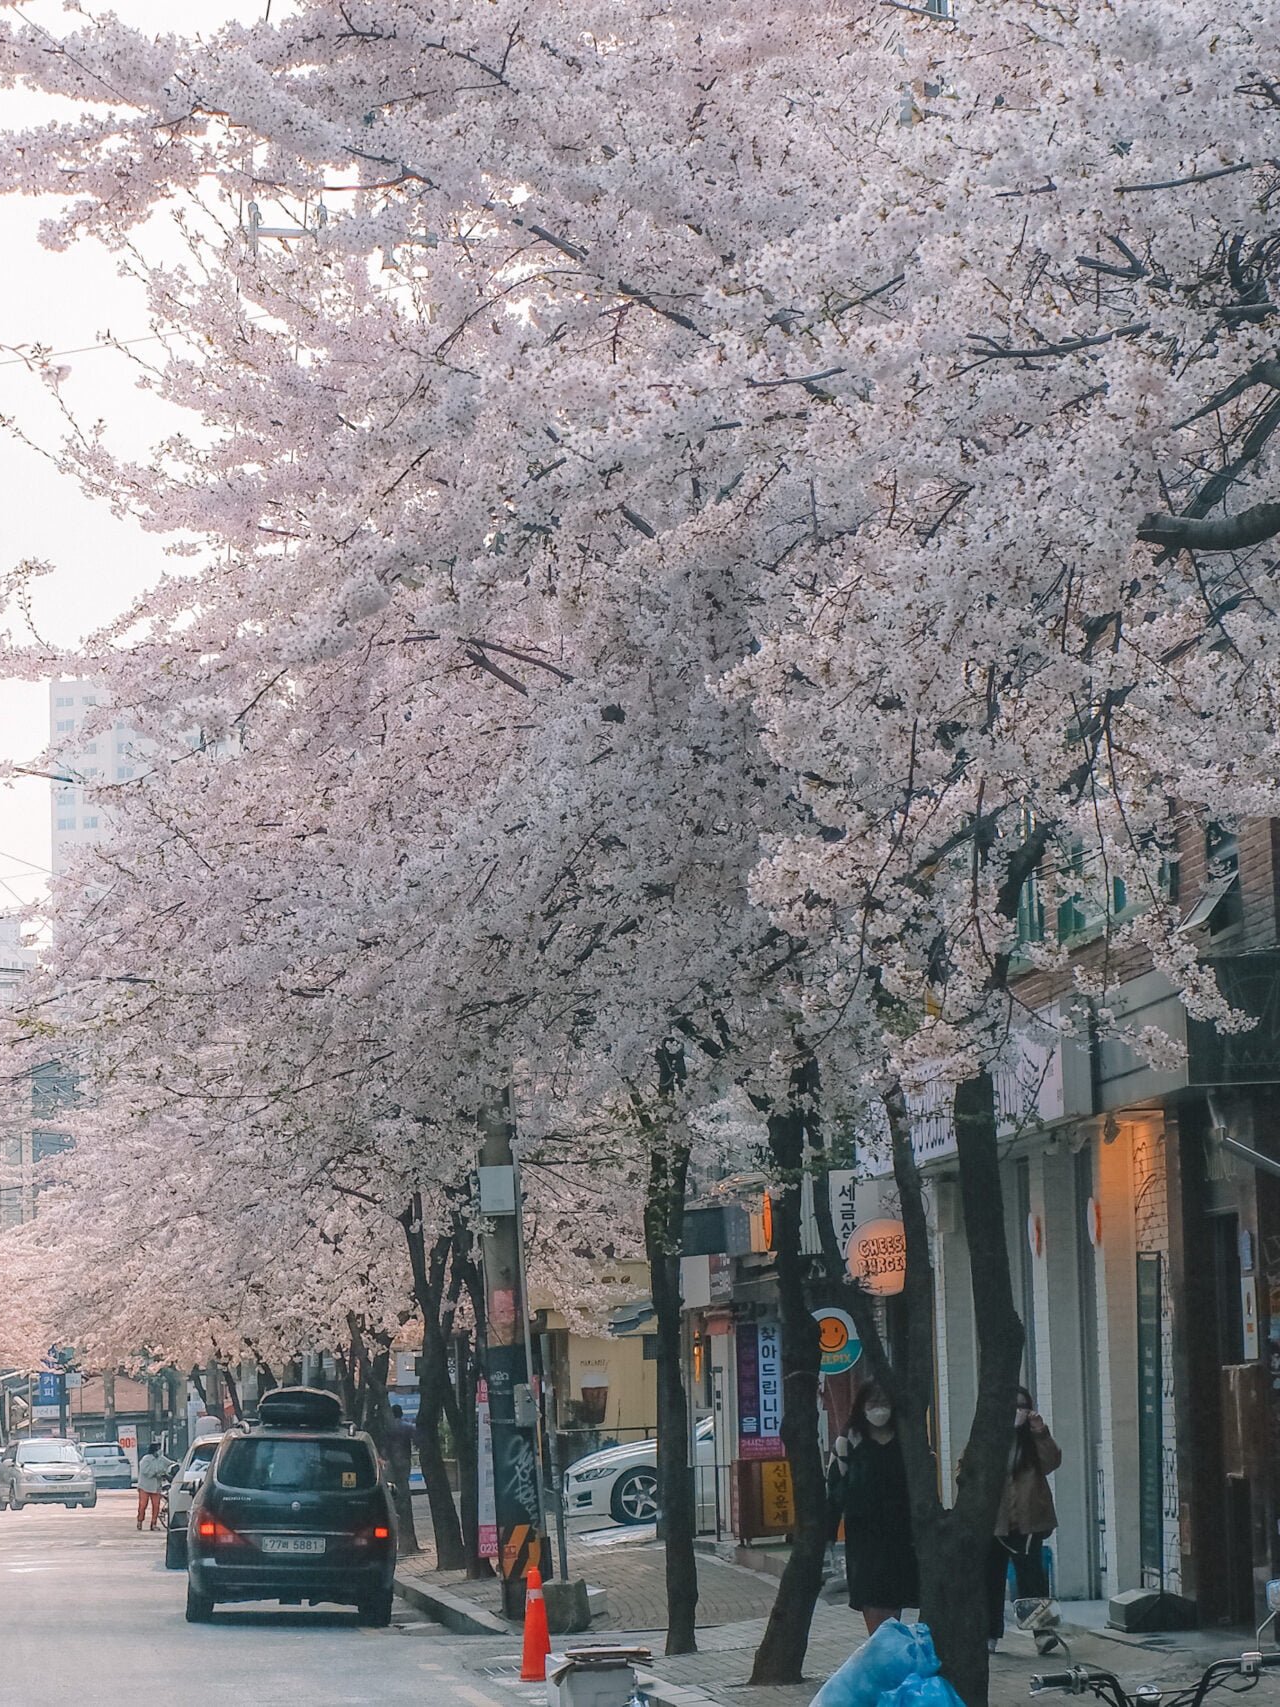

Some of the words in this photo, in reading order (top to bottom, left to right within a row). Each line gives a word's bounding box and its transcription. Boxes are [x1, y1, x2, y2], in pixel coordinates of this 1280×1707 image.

[838, 1183, 858, 1251] 세금삼
[858, 1234, 906, 1258] CHEES
[856, 1255, 906, 1279] BURGE
[43, 1375, 54, 1398] 커피
[761, 1326, 780, 1432] 찾아드립니다
[772, 1463, 789, 1525] 신년운세
[293, 1540, 318, 1551] 5881
